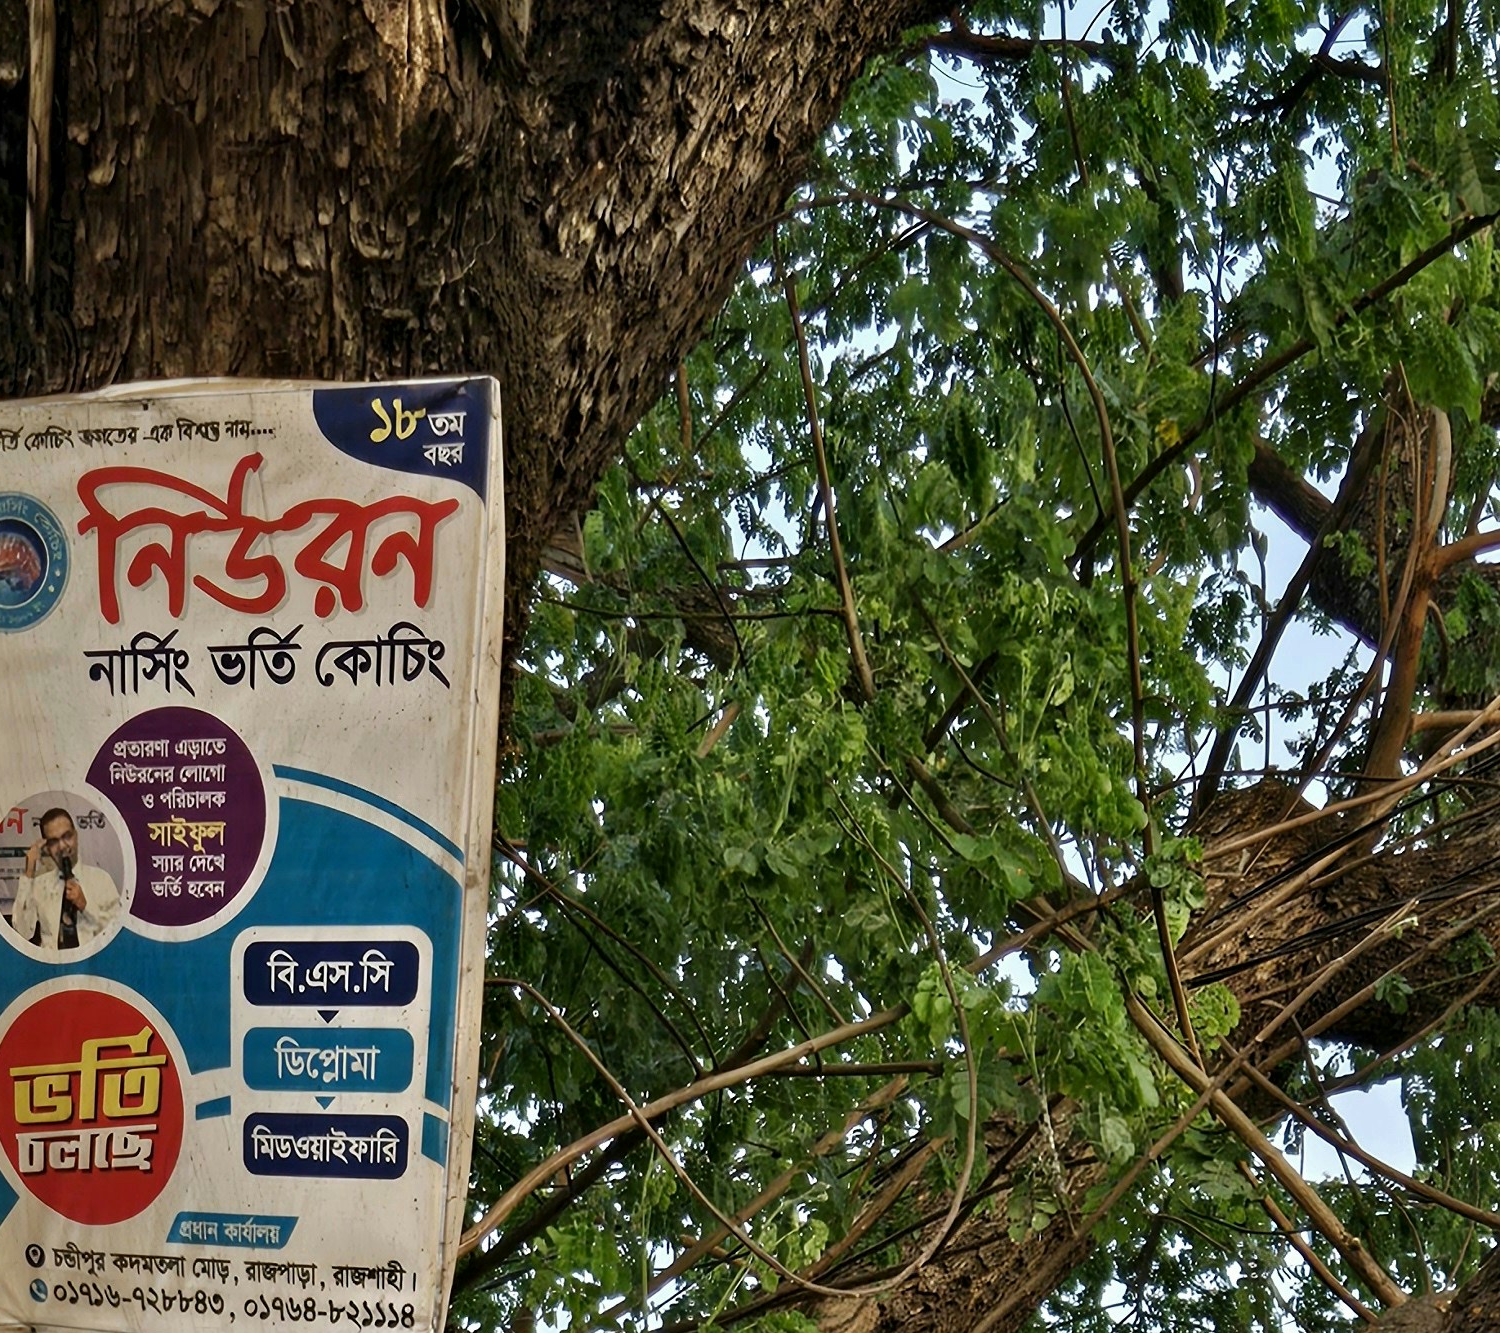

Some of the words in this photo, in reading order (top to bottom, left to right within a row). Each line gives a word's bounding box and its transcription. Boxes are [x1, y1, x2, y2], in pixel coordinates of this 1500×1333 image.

[370, 398, 426, 444] ১৮
[422, 442, 465, 467] বছর
[77, 452, 460, 625] নিউরন
[84, 628, 195, 697] নার্সিং
[207, 624, 303, 689] ভর্তি
[315, 620, 451, 690] কোচিং
[113, 739, 169, 759] প্রতারণা
[175, 737, 226, 760] এড়াতে
[109, 762, 174, 785] নিউরনের
[180, 763, 226, 783] লোগো
[141, 793, 155, 809] ও
[160, 787, 227, 809] পরিচালক
[147, 814, 227, 854] সাইফুল
[152, 854, 185, 873] স্যার
[189, 852, 226, 873] দেখে
[150, 875, 182, 899] ভর্তি
[187, 880, 225, 899] হবেন
[8, 1026, 167, 1123] ভর্তি
[273, 1037, 381, 1083] ডিপ্লোমা
[15, 1124, 160, 1175] চলছে
[252, 1119, 400, 1166] মিডওয়াইফারি
[111, 1253, 187, 1277] কদমতলা
